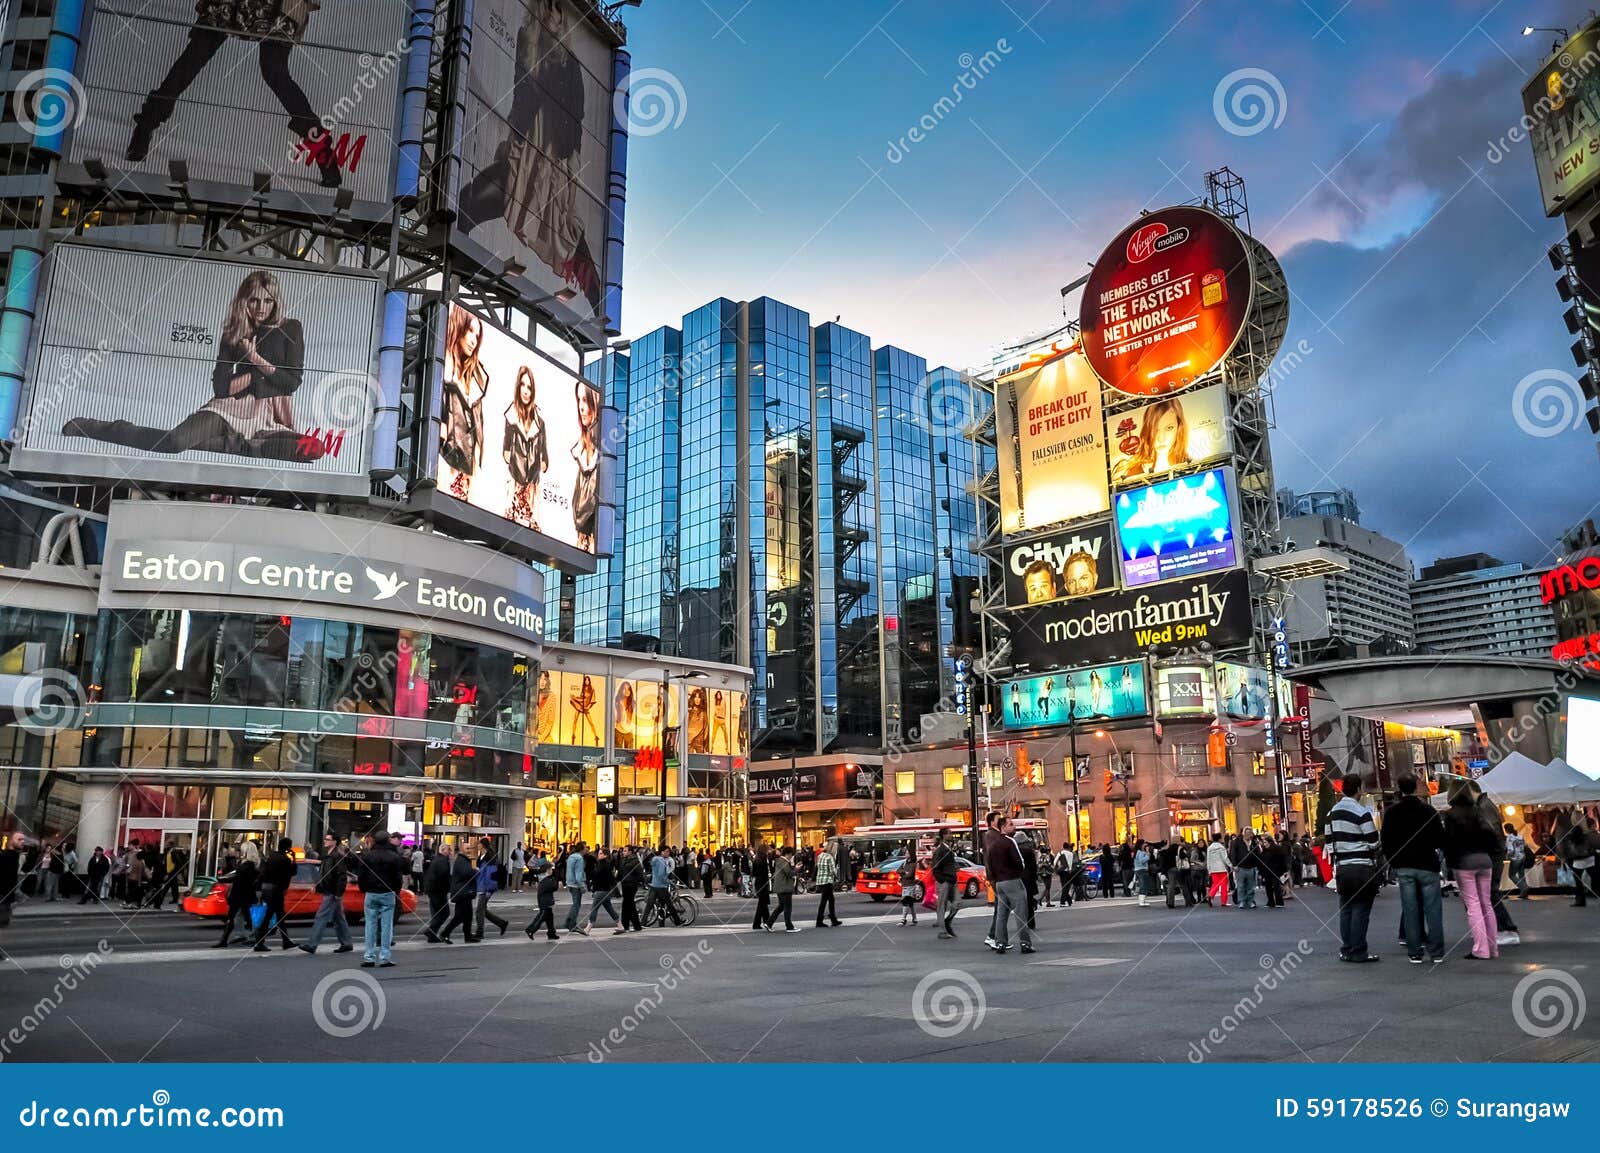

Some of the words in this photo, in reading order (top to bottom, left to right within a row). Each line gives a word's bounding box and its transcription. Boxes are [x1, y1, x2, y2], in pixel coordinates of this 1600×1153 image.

[1553, 147, 1584, 184] NEW
[1132, 231, 1160, 258] Virgin
[1157, 232, 1184, 248] mobile
[1100, 278, 1148, 305] MEMBERS
[1151, 268, 1170, 286] GET
[1101, 303, 1128, 325] THE
[1132, 279, 1192, 315] FASTEST
[171, 331, 213, 345] $24.95
[1103, 306, 1175, 344] NETWORK.
[1144, 336, 1153, 345] TO
[1153, 332, 1162, 342] BE
[1028, 399, 1064, 421] BREAK
[1066, 391, 1087, 408] OUT
[1029, 421, 1043, 436] OF
[1044, 414, 1065, 431] THE
[1068, 406, 1091, 424] CITY
[1032, 441, 1066, 461] FALLSVIEW
[1068, 433, 1094, 450] CASINO
[122, 550, 225, 582] Eaton
[238, 557, 353, 593] Centre
[417, 578, 487, 617] Eaton
[493, 597, 543, 636] Centre
[1135, 625, 1172, 647] Wed
[1175, 624, 1207, 641] 9PM
[1273, 616, 1287, 667] Yong
[1172, 682, 1200, 694] XXI
[336, 790, 366, 799] Dundas
